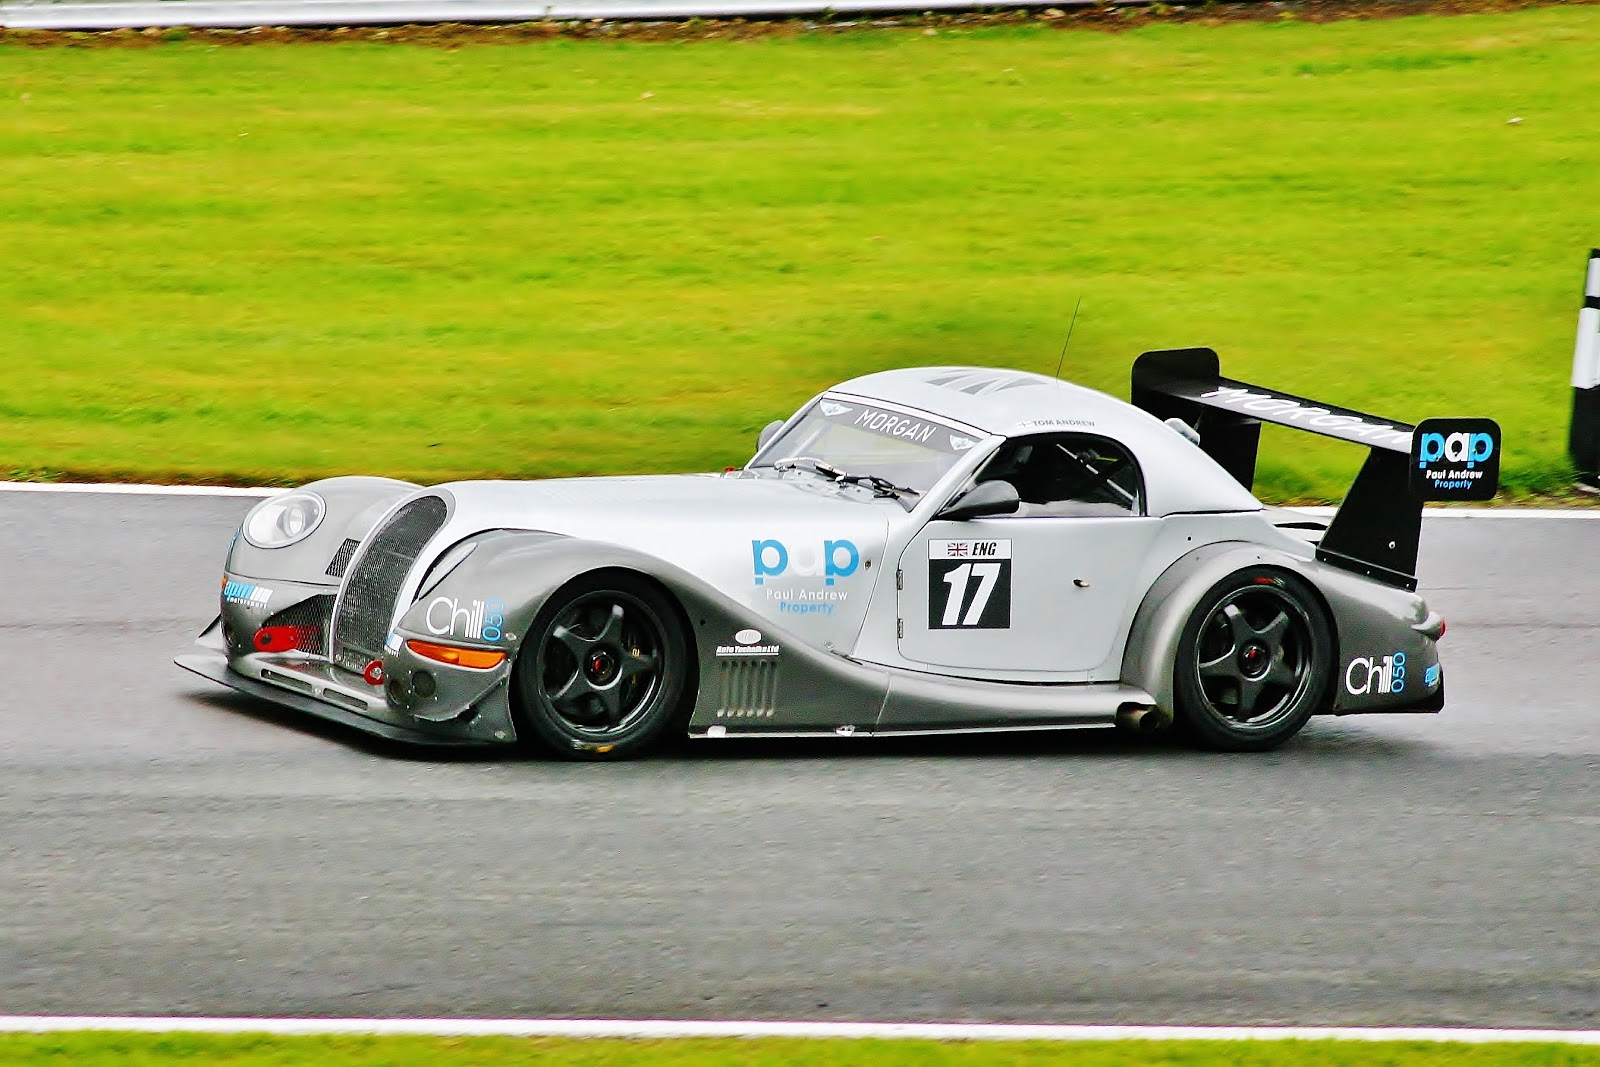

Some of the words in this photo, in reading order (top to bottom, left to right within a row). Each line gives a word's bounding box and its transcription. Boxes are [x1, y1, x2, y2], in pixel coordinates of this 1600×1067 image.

[853, 408, 937, 443] MORGAN
[1033, 419, 1055, 427] TOM
[1056, 419, 1095, 427] ANDREW
[1419, 432, 1494, 469] pap
[1426, 469, 1446, 479] Paul
[1448, 469, 1484, 479] Andrew
[1434, 479, 1473, 490] Property
[972, 542, 997, 556] ENG
[766, 588, 794, 601] Paul
[798, 588, 848, 601] Andrew
[942, 562, 1002, 626] 17
[780, 602, 835, 615] Property
[425, 596, 485, 640] Chill
[1345, 656, 1394, 695] Chill
